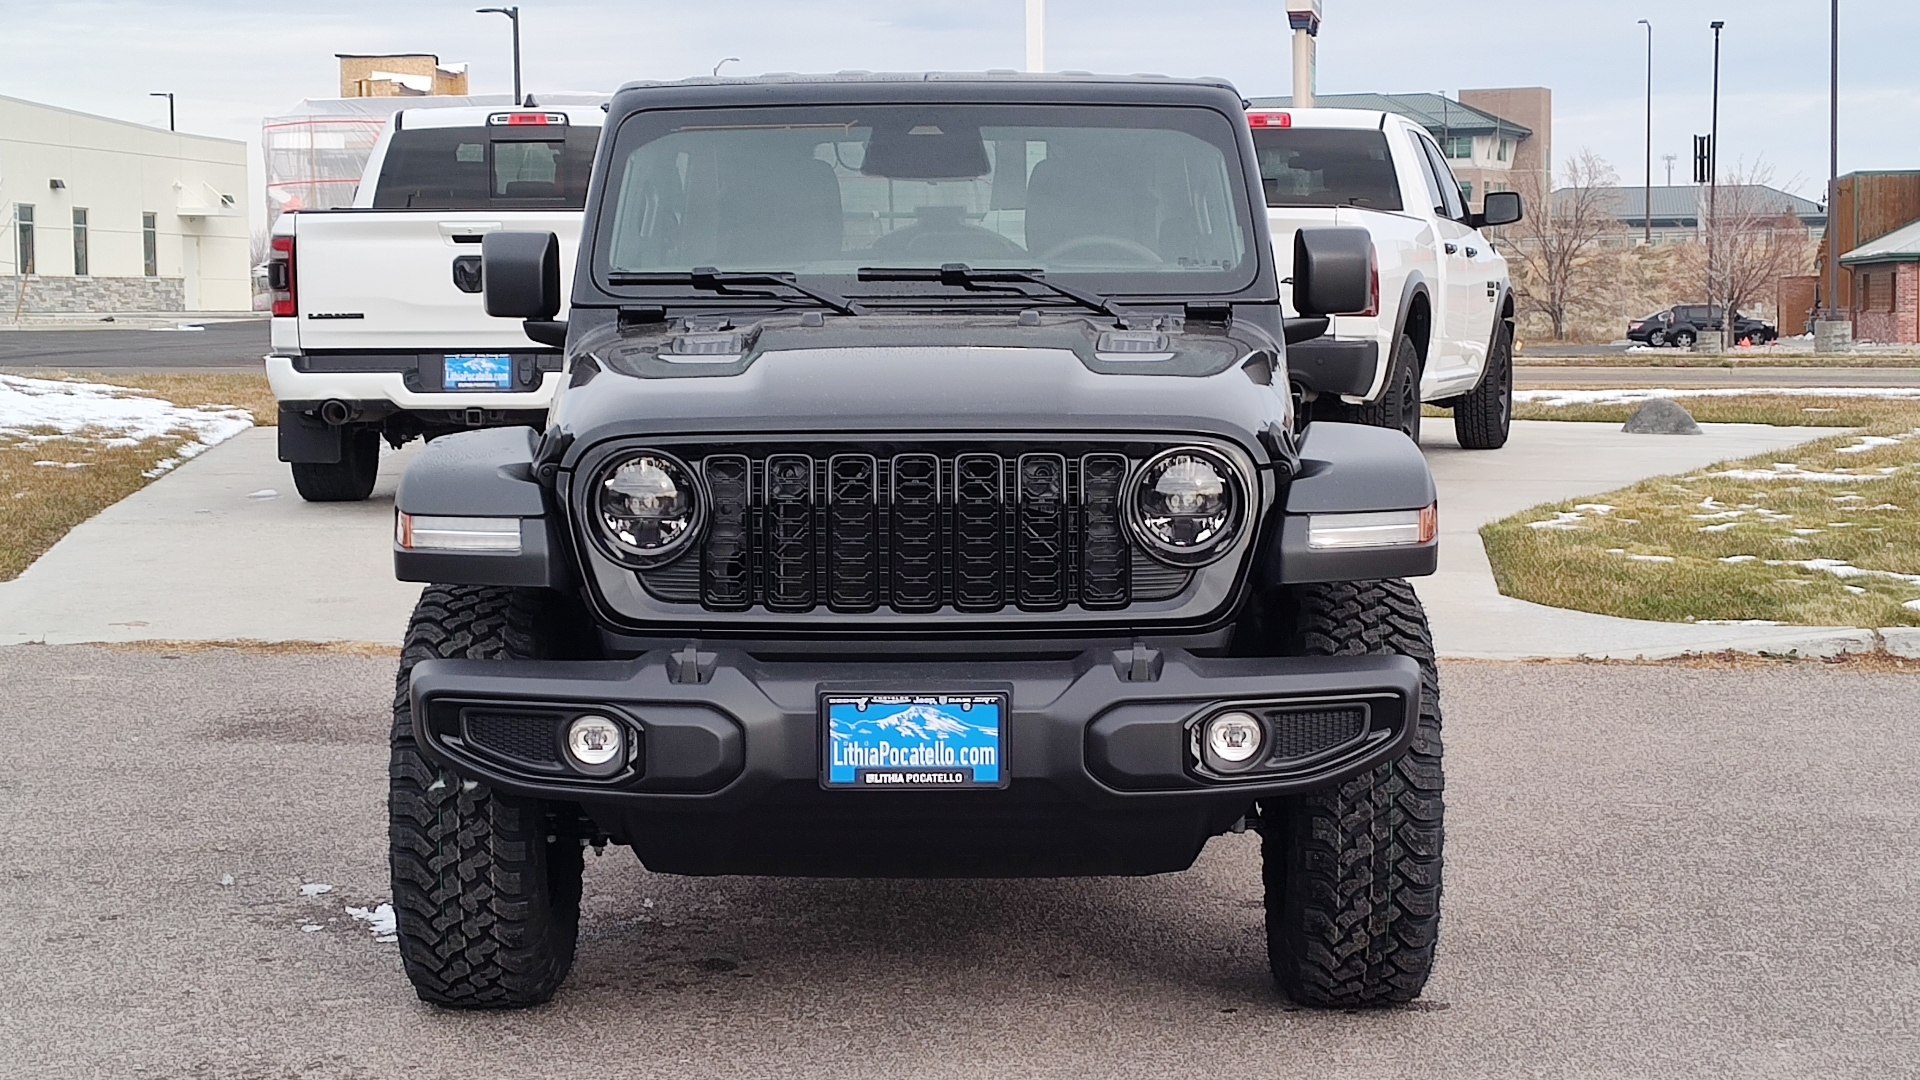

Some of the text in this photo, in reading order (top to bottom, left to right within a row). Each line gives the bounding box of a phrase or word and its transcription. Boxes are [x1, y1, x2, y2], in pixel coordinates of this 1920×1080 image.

[833, 740, 995, 766] LithiaPocatello.com
[875, 773, 963, 784] LITHIA POCATELLO
